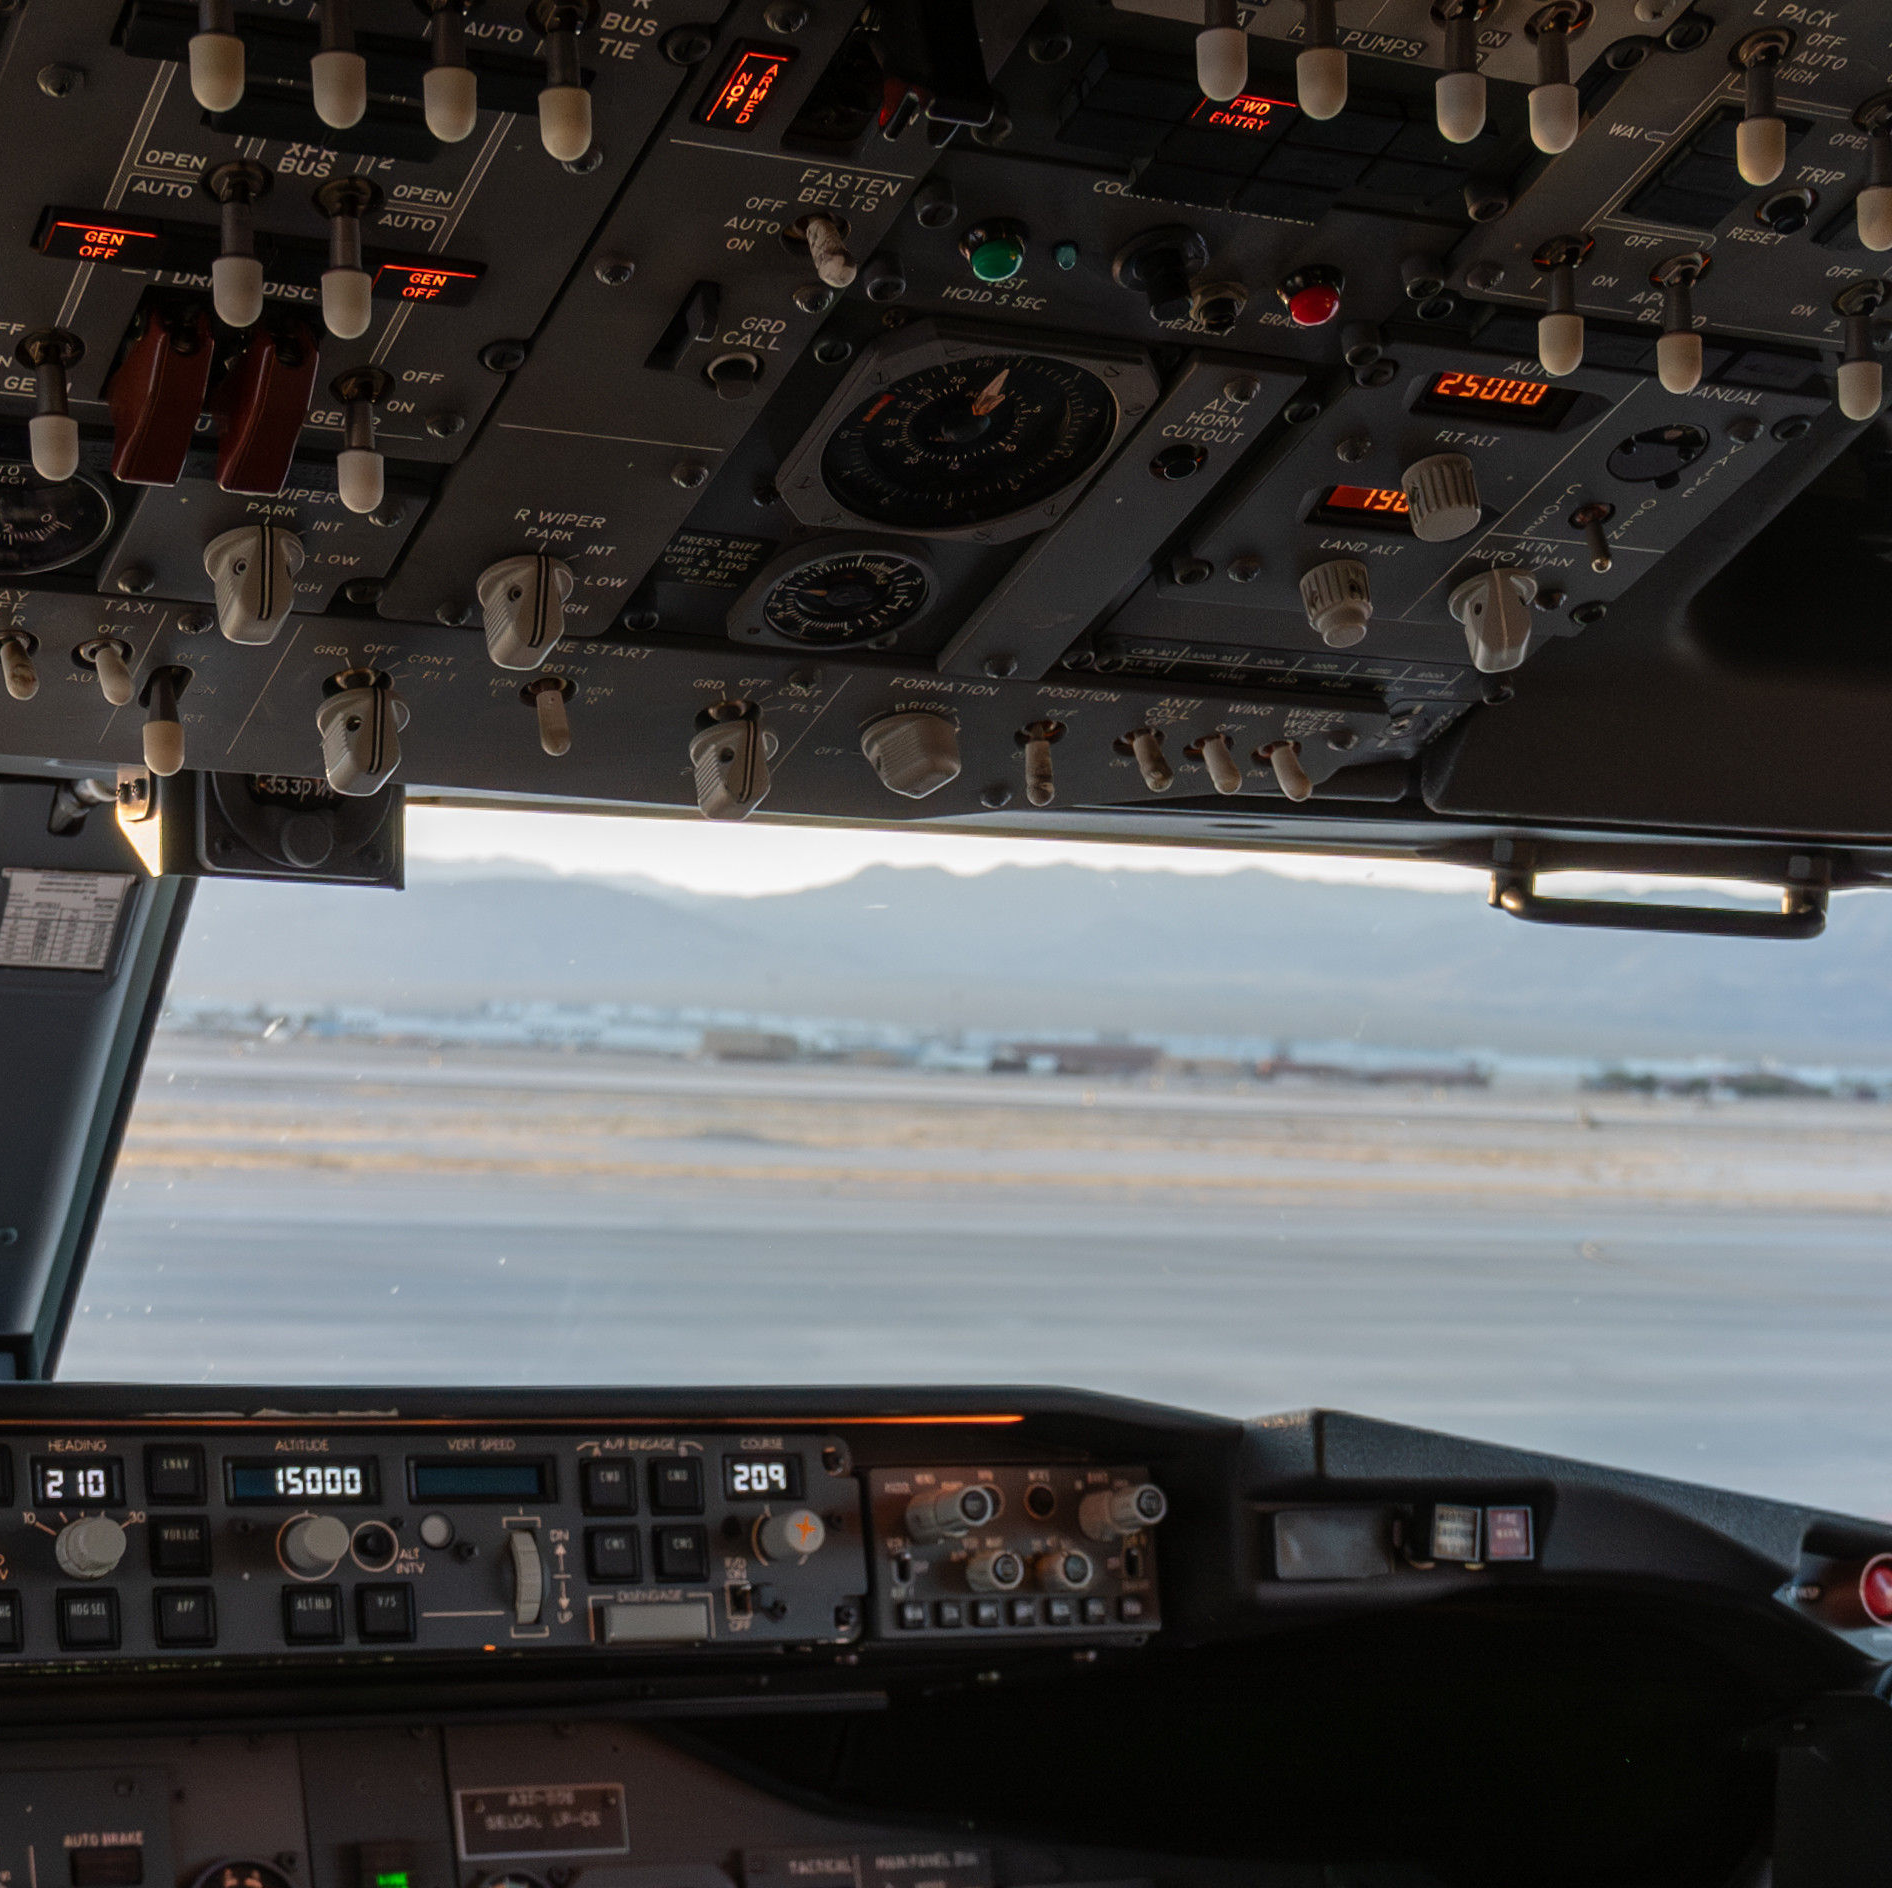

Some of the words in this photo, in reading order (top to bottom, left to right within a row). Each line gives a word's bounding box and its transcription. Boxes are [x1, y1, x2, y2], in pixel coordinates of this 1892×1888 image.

[464, 21, 524, 43] AUTO
[600, 11, 658, 37] BUS
[597, 38, 640, 60] TIE
[1341, 31, 1422, 59] PUMPS
[1806, 33, 1847, 50] OFF
[1794, 51, 1848, 70] AUTO
[735, 64, 778, 125] ARMED
[1209, 111, 1271, 132] ENTRY
[145, 150, 207, 170] OPEN
[277, 157, 332, 178] BUS
[800, 168, 901, 198] FASTEN
[1795, 165, 1846, 184] TRIP
[132, 180, 193, 199] AUTO
[392, 185, 453, 204] OPEN
[746, 197, 788, 213] OFF
[378, 214, 436, 231] AUTO
[724, 216, 781, 235] AUTO
[84, 230, 125, 246] GEN
[726, 237, 756, 252] ON
[1726, 226, 1789, 245] RESET
[409, 274, 447, 287] GEN
[941, 286, 993, 303] HOLD
[994, 293, 1008, 306] 5
[1011, 296, 1047, 311] SEC
[741, 317, 787, 334] GRD
[722, 331, 781, 351] CALL
[402, 370, 444, 384] OFF
[1437, 373, 1548, 406] 25000
[1186, 410, 1245, 428] HORN
[1162, 425, 1244, 446] CUTOUT
[1435, 430, 1461, 443] FLT
[1465, 434, 1500, 448] ALT
[247, 502, 298, 517] PARK
[515, 508, 531, 521] R
[538, 512, 605, 529] WIPER
[312, 521, 343, 532] INT
[525, 527, 574, 541] PARK
[1320, 538, 1368, 553] LAND
[1370, 542, 1405, 556] ALT
[104, 600, 156, 615] TAXI
[890, 676, 1000, 697] FORMATION
[1037, 686, 1121, 703] POSITION
[48, 1440, 107, 1452] HEADING
[275, 1467, 362, 1495] 15000
[732, 1462, 787, 1492] 209
